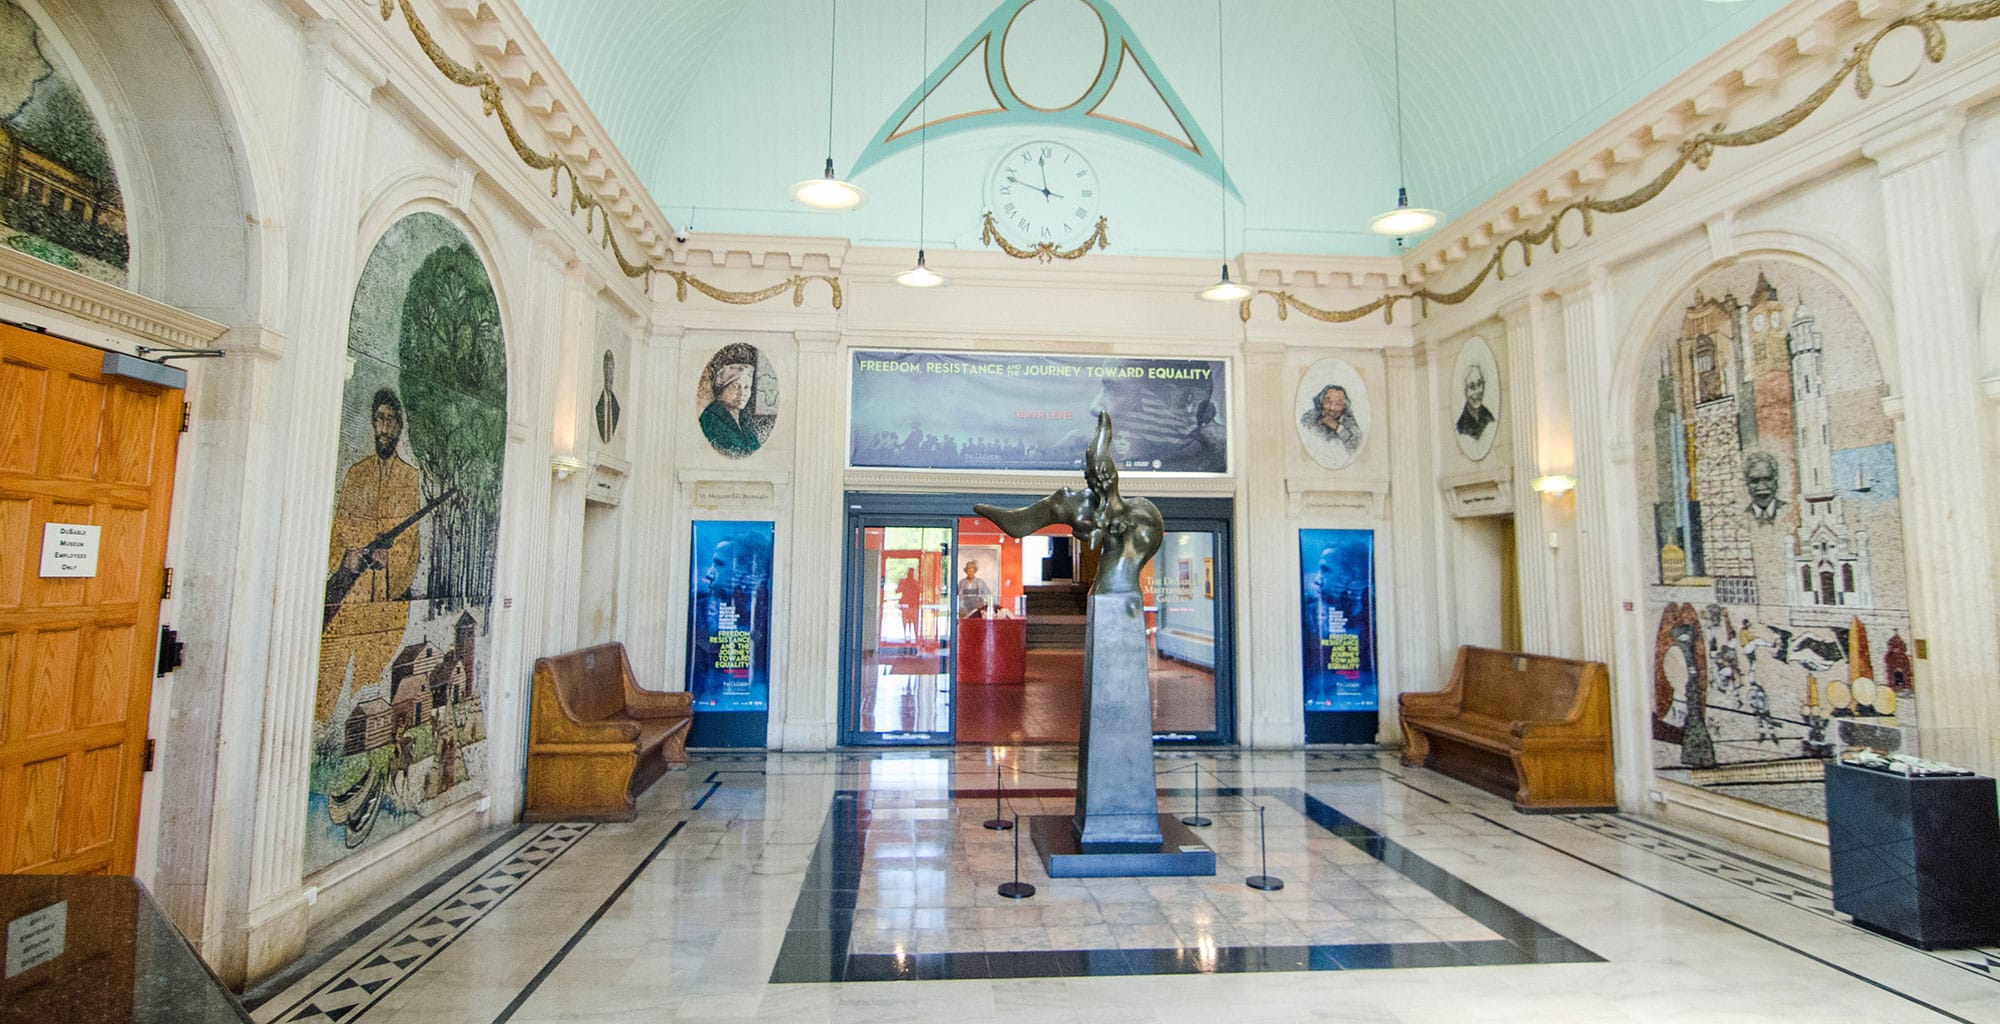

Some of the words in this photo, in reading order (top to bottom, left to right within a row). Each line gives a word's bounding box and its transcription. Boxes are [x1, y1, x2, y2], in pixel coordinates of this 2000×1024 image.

[926, 361, 1003, 375] RESISTANCE
[1024, 364, 1081, 376] JOURNEY
[1087, 366, 1144, 378] TOWARD
[1148, 367, 1211, 380] EQUALITY
